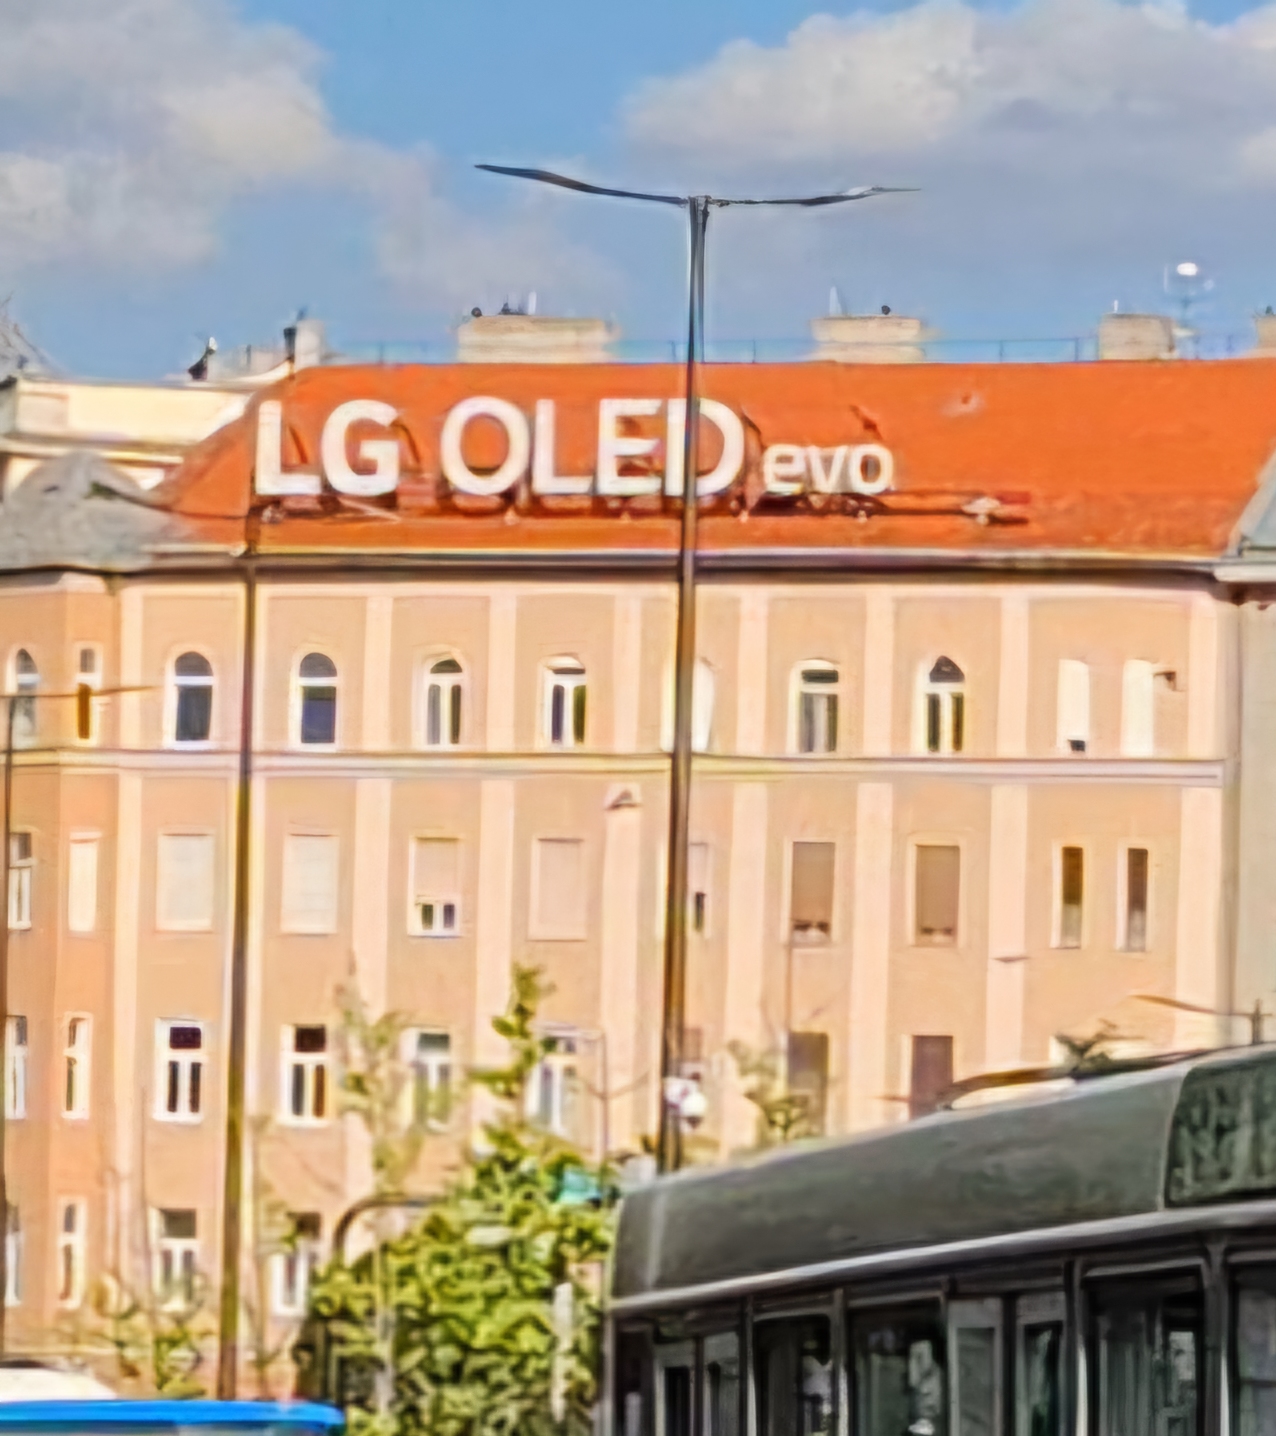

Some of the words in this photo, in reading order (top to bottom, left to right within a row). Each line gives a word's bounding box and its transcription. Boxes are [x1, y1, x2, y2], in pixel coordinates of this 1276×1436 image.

[253, 399, 402, 496] LG
[440, 395, 746, 497] OLED
[763, 442, 895, 493] evo
